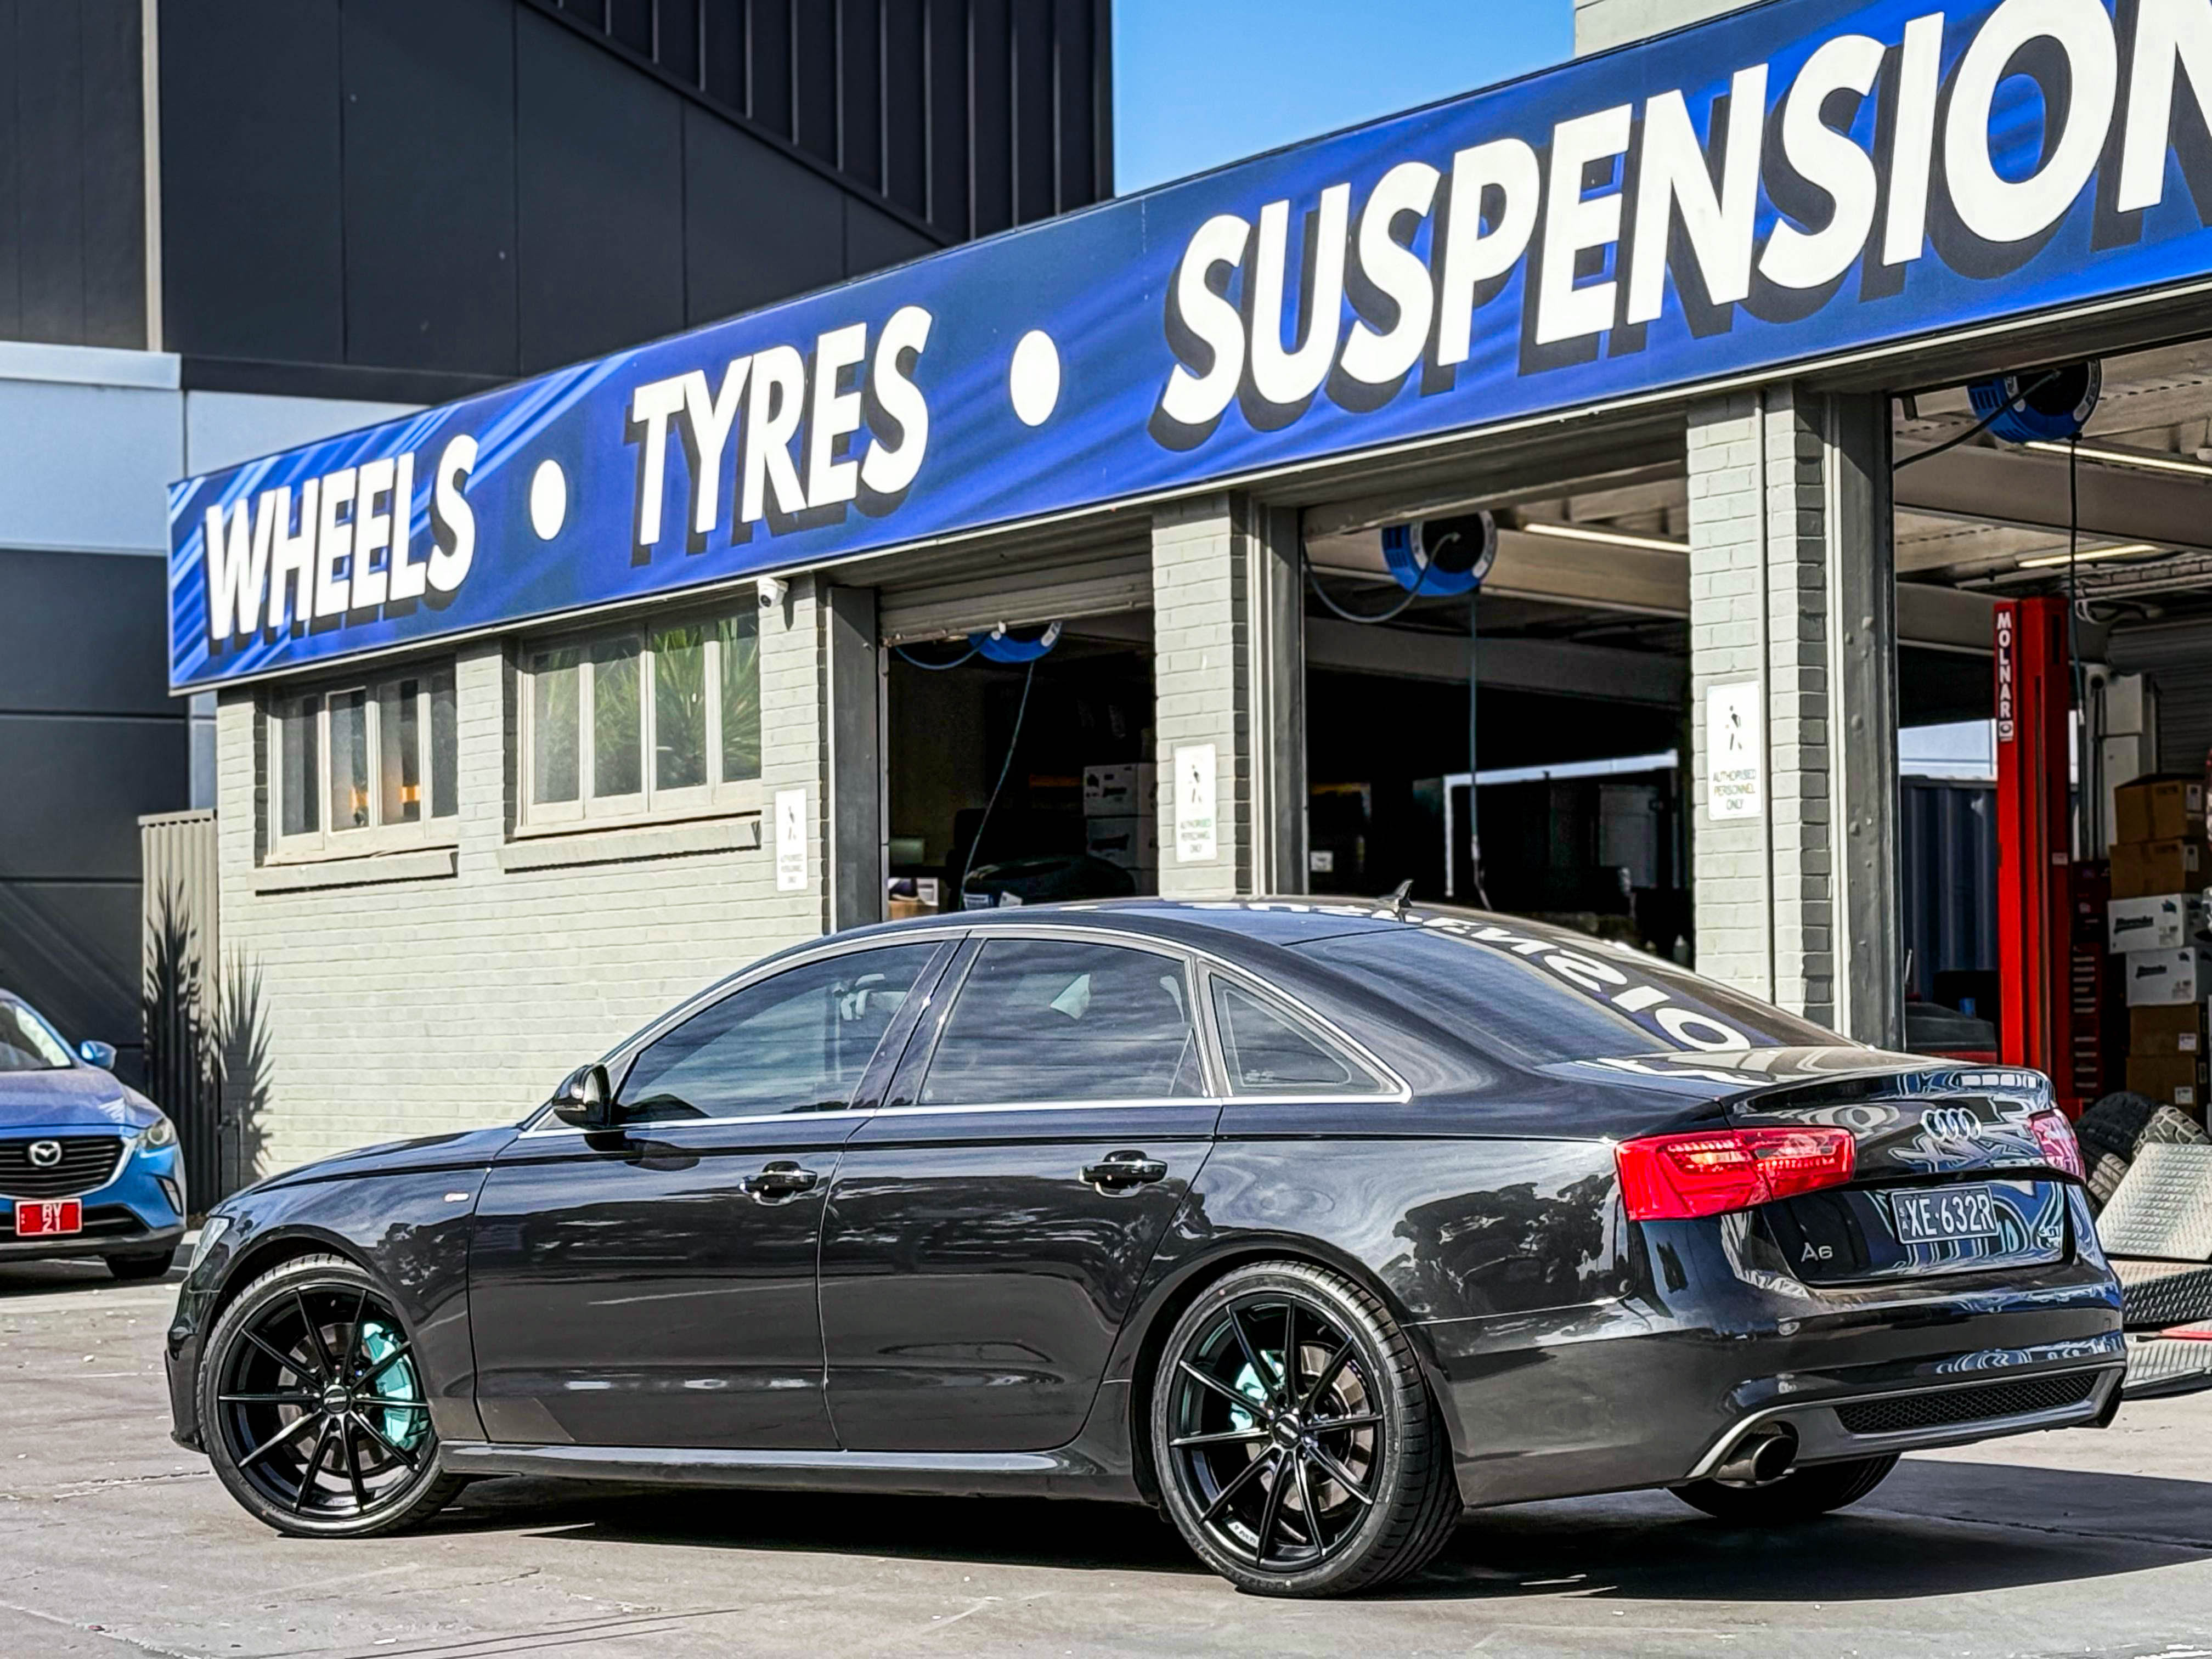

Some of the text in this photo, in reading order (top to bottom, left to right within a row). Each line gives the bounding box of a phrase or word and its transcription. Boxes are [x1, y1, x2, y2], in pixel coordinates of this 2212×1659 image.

[205, 434, 479, 641] WHEELS
[633, 306, 933, 545] TYRES
[1996, 612, 2012, 718] MOLNAR
[1801, 1242, 1833, 1262] A6
